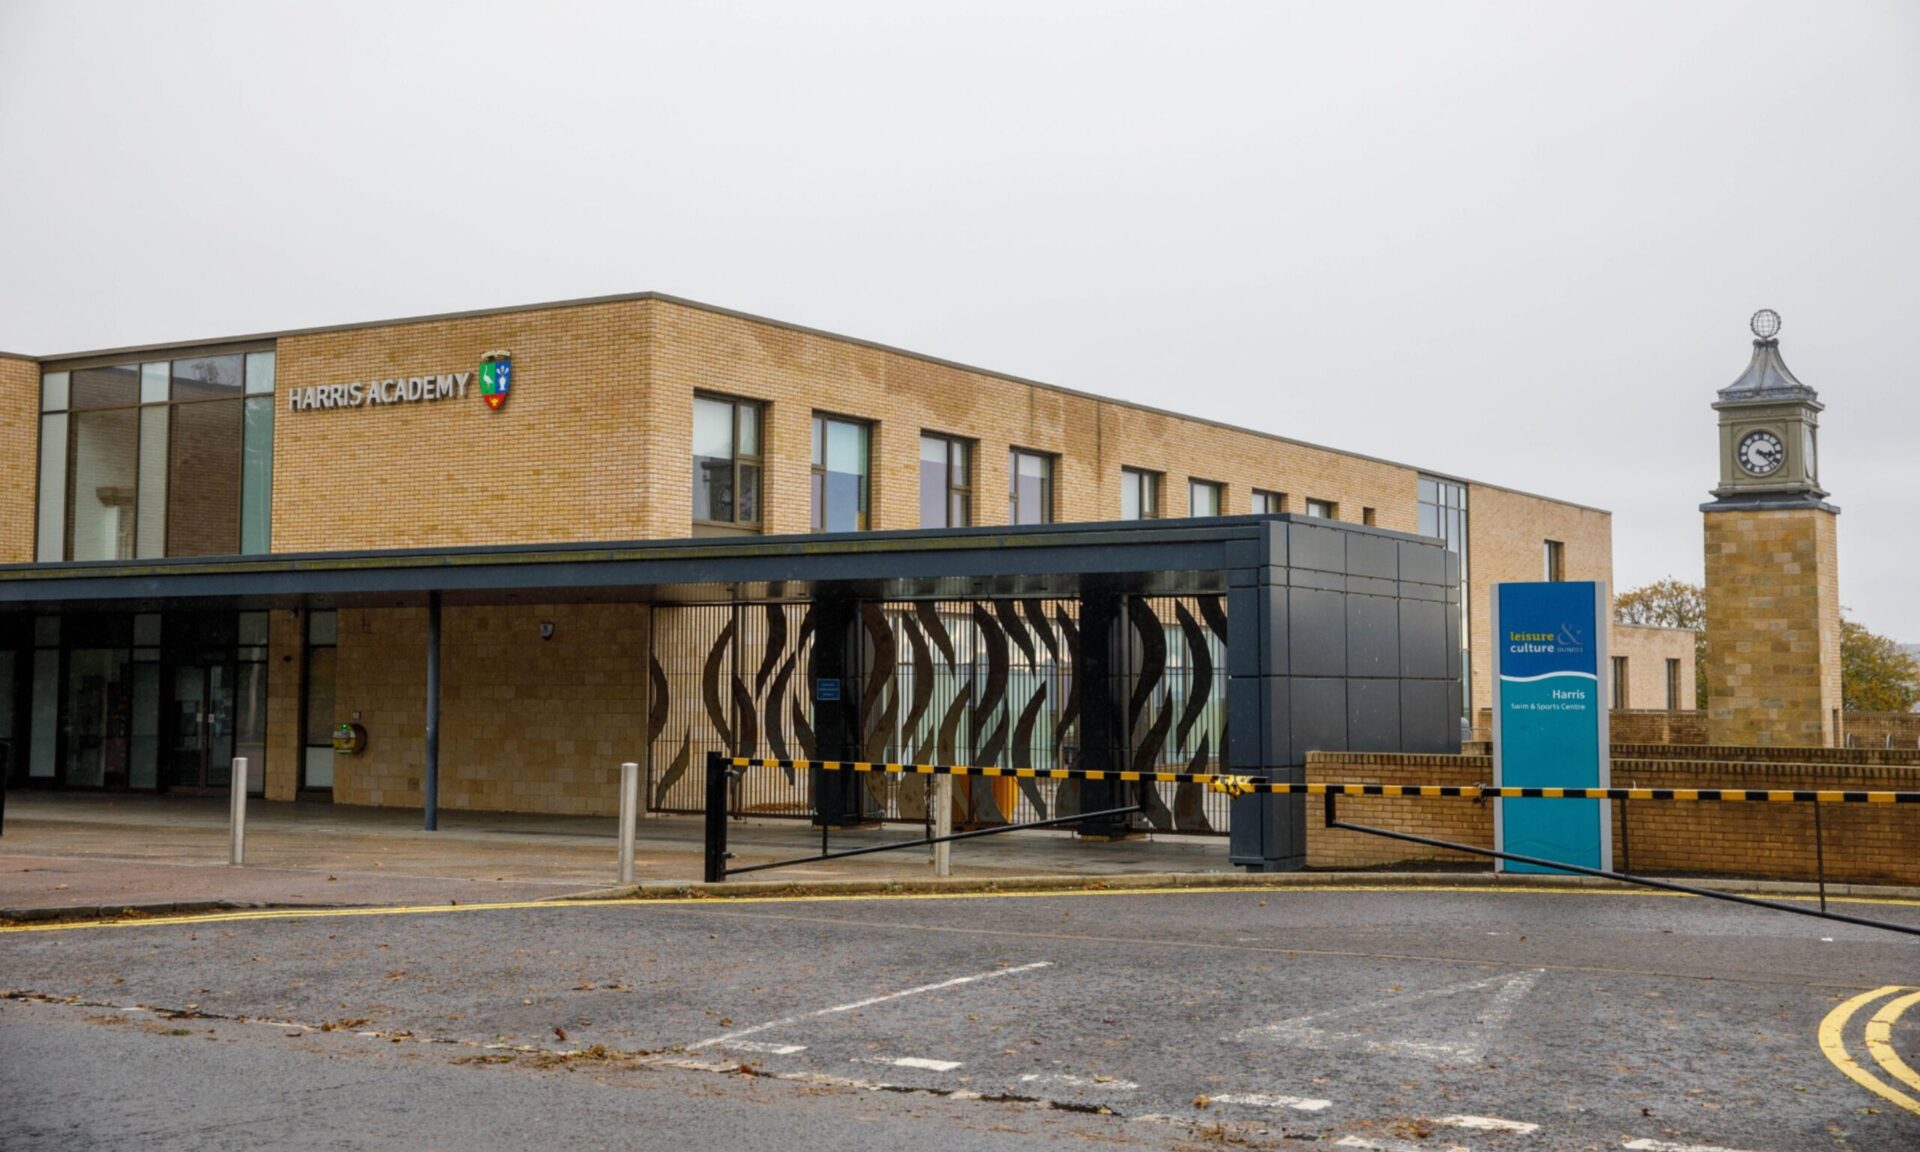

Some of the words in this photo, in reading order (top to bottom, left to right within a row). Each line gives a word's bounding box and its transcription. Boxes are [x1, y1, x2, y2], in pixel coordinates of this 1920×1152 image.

[288, 382, 363, 411] HARRIS
[367, 372, 472, 405] ACADEMY
[1509, 631, 1554, 641] leisure
[1510, 643, 1554, 653] culture
[1552, 689, 1585, 699] Harris
[1537, 703, 1560, 711] Sports
